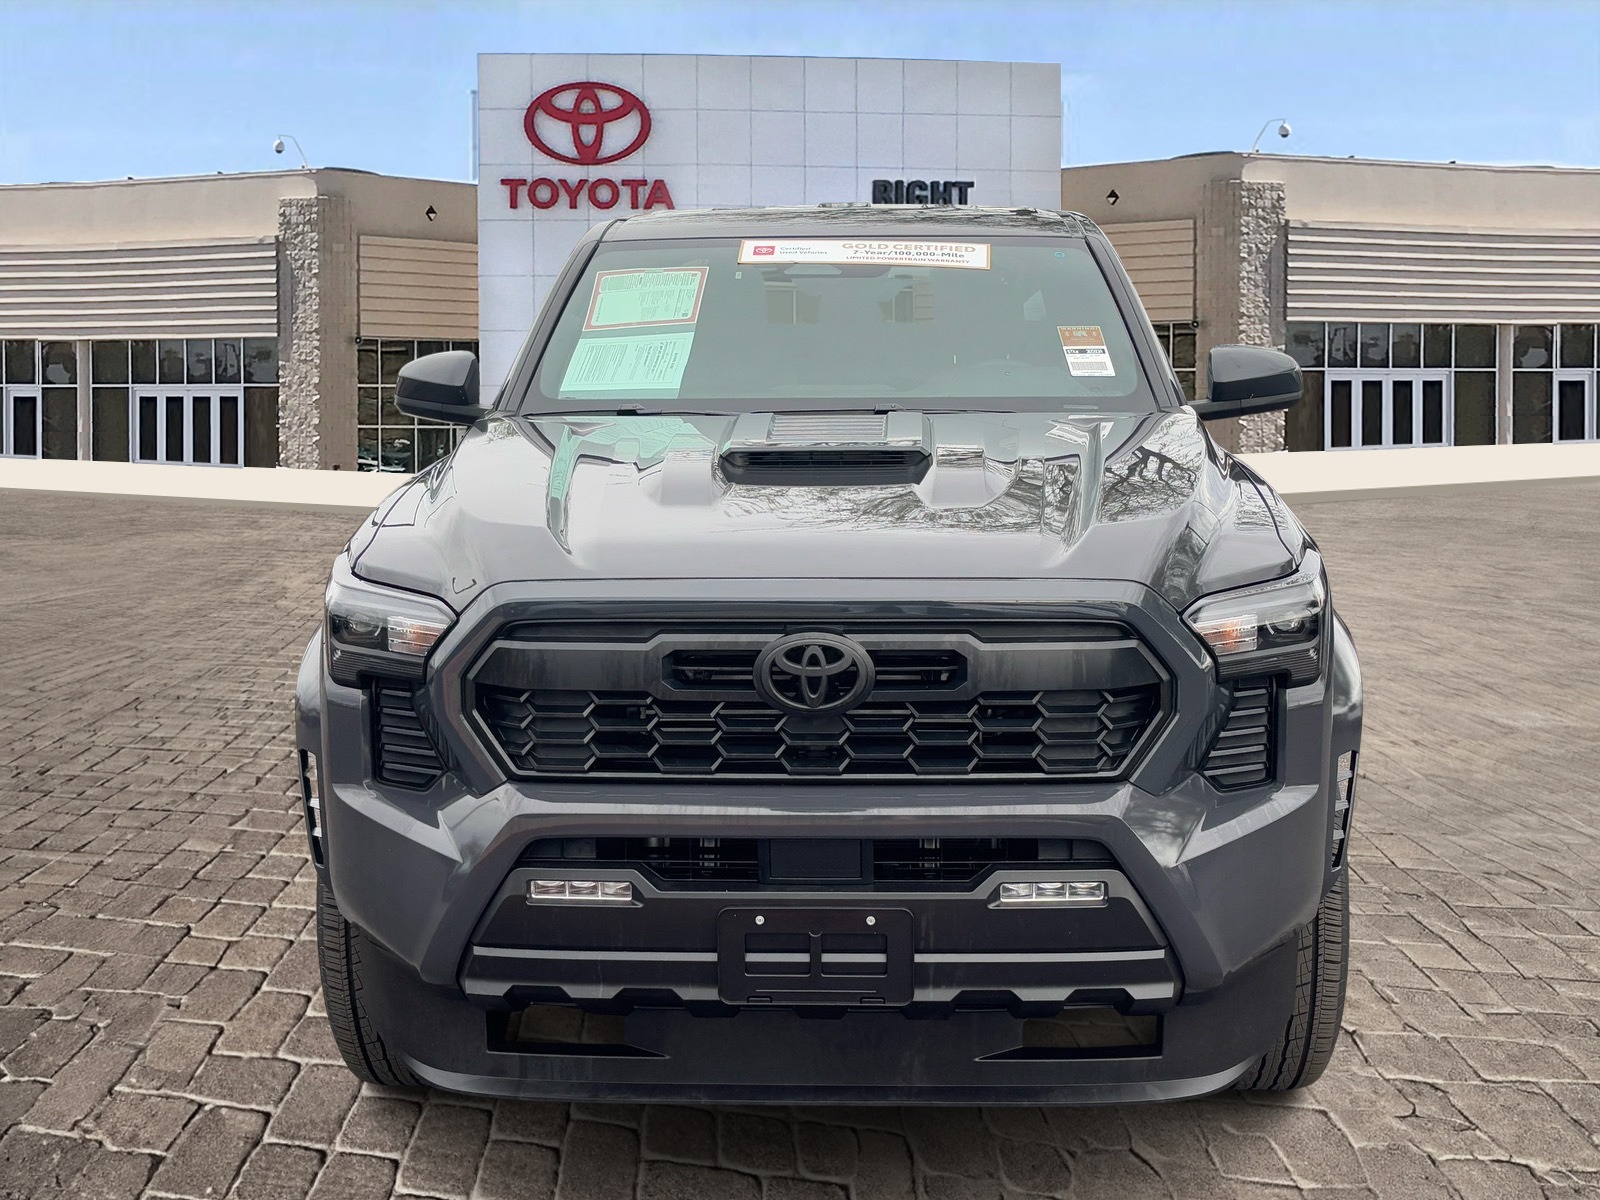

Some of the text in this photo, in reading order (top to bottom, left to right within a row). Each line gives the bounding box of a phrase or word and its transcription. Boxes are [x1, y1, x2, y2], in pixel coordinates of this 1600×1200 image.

[501, 178, 675, 209] TOYOTA
[872, 179, 975, 205] RIGHT
[853, 249, 965, 258] 7-Year/100,000-Mile
[893, 244, 976, 252] CERTIFIED
